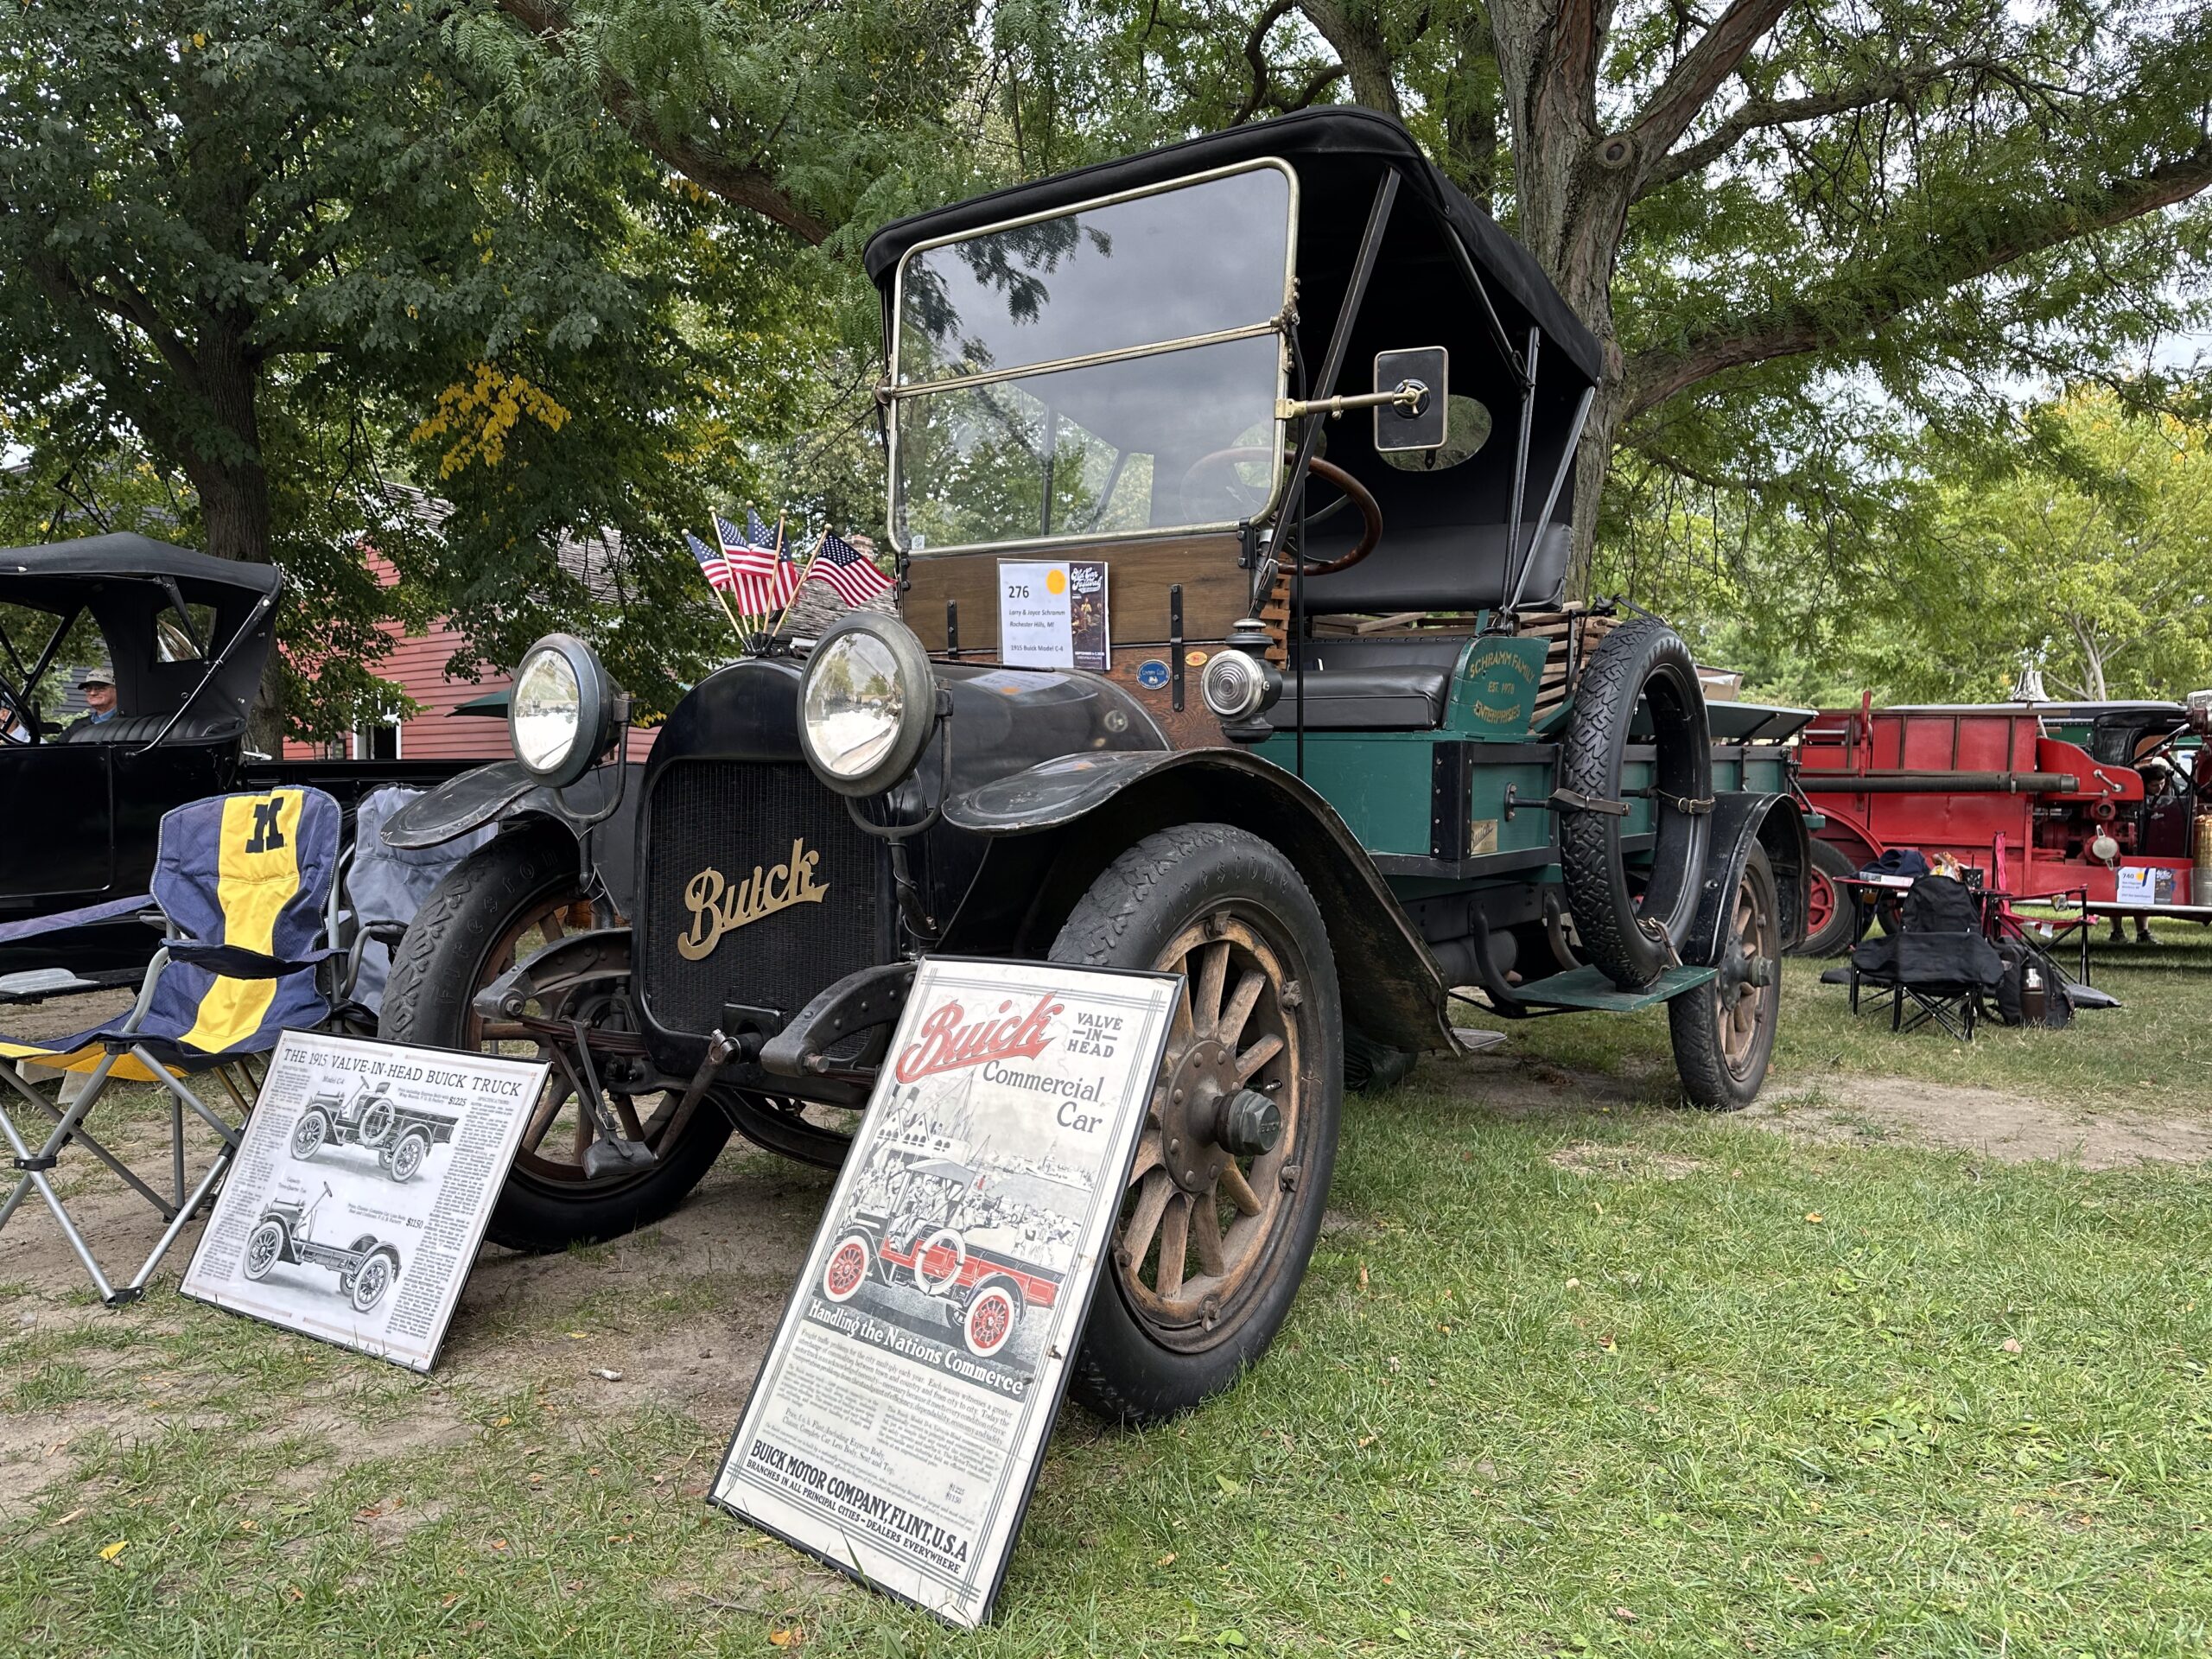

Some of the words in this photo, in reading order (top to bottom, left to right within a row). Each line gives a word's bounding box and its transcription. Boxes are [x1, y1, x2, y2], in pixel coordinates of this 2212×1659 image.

[1008, 585, 1030, 599] 276
[1009, 609, 1021, 618] Larry
[1028, 609, 1040, 618] Joyce
[1470, 650, 1512, 679] SCHRAMM
[1511, 653, 1535, 684] FAMILY
[1473, 699, 1521, 724] ENTERPRISES
[245, 797, 284, 854] M
[677, 837, 830, 961] Buick
[895, 990, 1065, 1084] Buick
[1077, 1011, 1124, 1032] VALVE
[1066, 1039, 1116, 1058] HEAD
[282, 1048, 307, 1063] THE
[308, 1052, 328, 1065] 1915
[426, 1071, 467, 1088] BUICK
[470, 1077, 521, 1096] TRUCK
[982, 1060, 1105, 1103] Commercial
[448, 1096, 467, 1106] $1225
[1057, 1101, 1103, 1134] Car
[405, 1217, 423, 1229] $1150
[808, 1299, 861, 1338] Handling
[860, 1319, 884, 1343] the
[883, 1326, 943, 1365] Nations
[944, 1349, 1024, 1395] Commerce
[750, 1440, 787, 1470] BUICK
[785, 1456, 828, 1490] MOTOR
[825, 1478, 891, 1522] COMPANY,
[887, 1507, 934, 1545] FLINT,
[931, 1528, 970, 1561] U.S.A
[944, 1491, 962, 1504] $1150
[747, 1459, 780, 1481] BRANCHES
[780, 1476, 789, 1486] IN
[788, 1480, 803, 1493] ALL
[802, 1488, 836, 1510] PRINCIPAL
[837, 1504, 860, 1522] CITIES
[866, 1519, 901, 1542] DEALERS
[903, 1539, 960, 1573] EVERYWHERE
